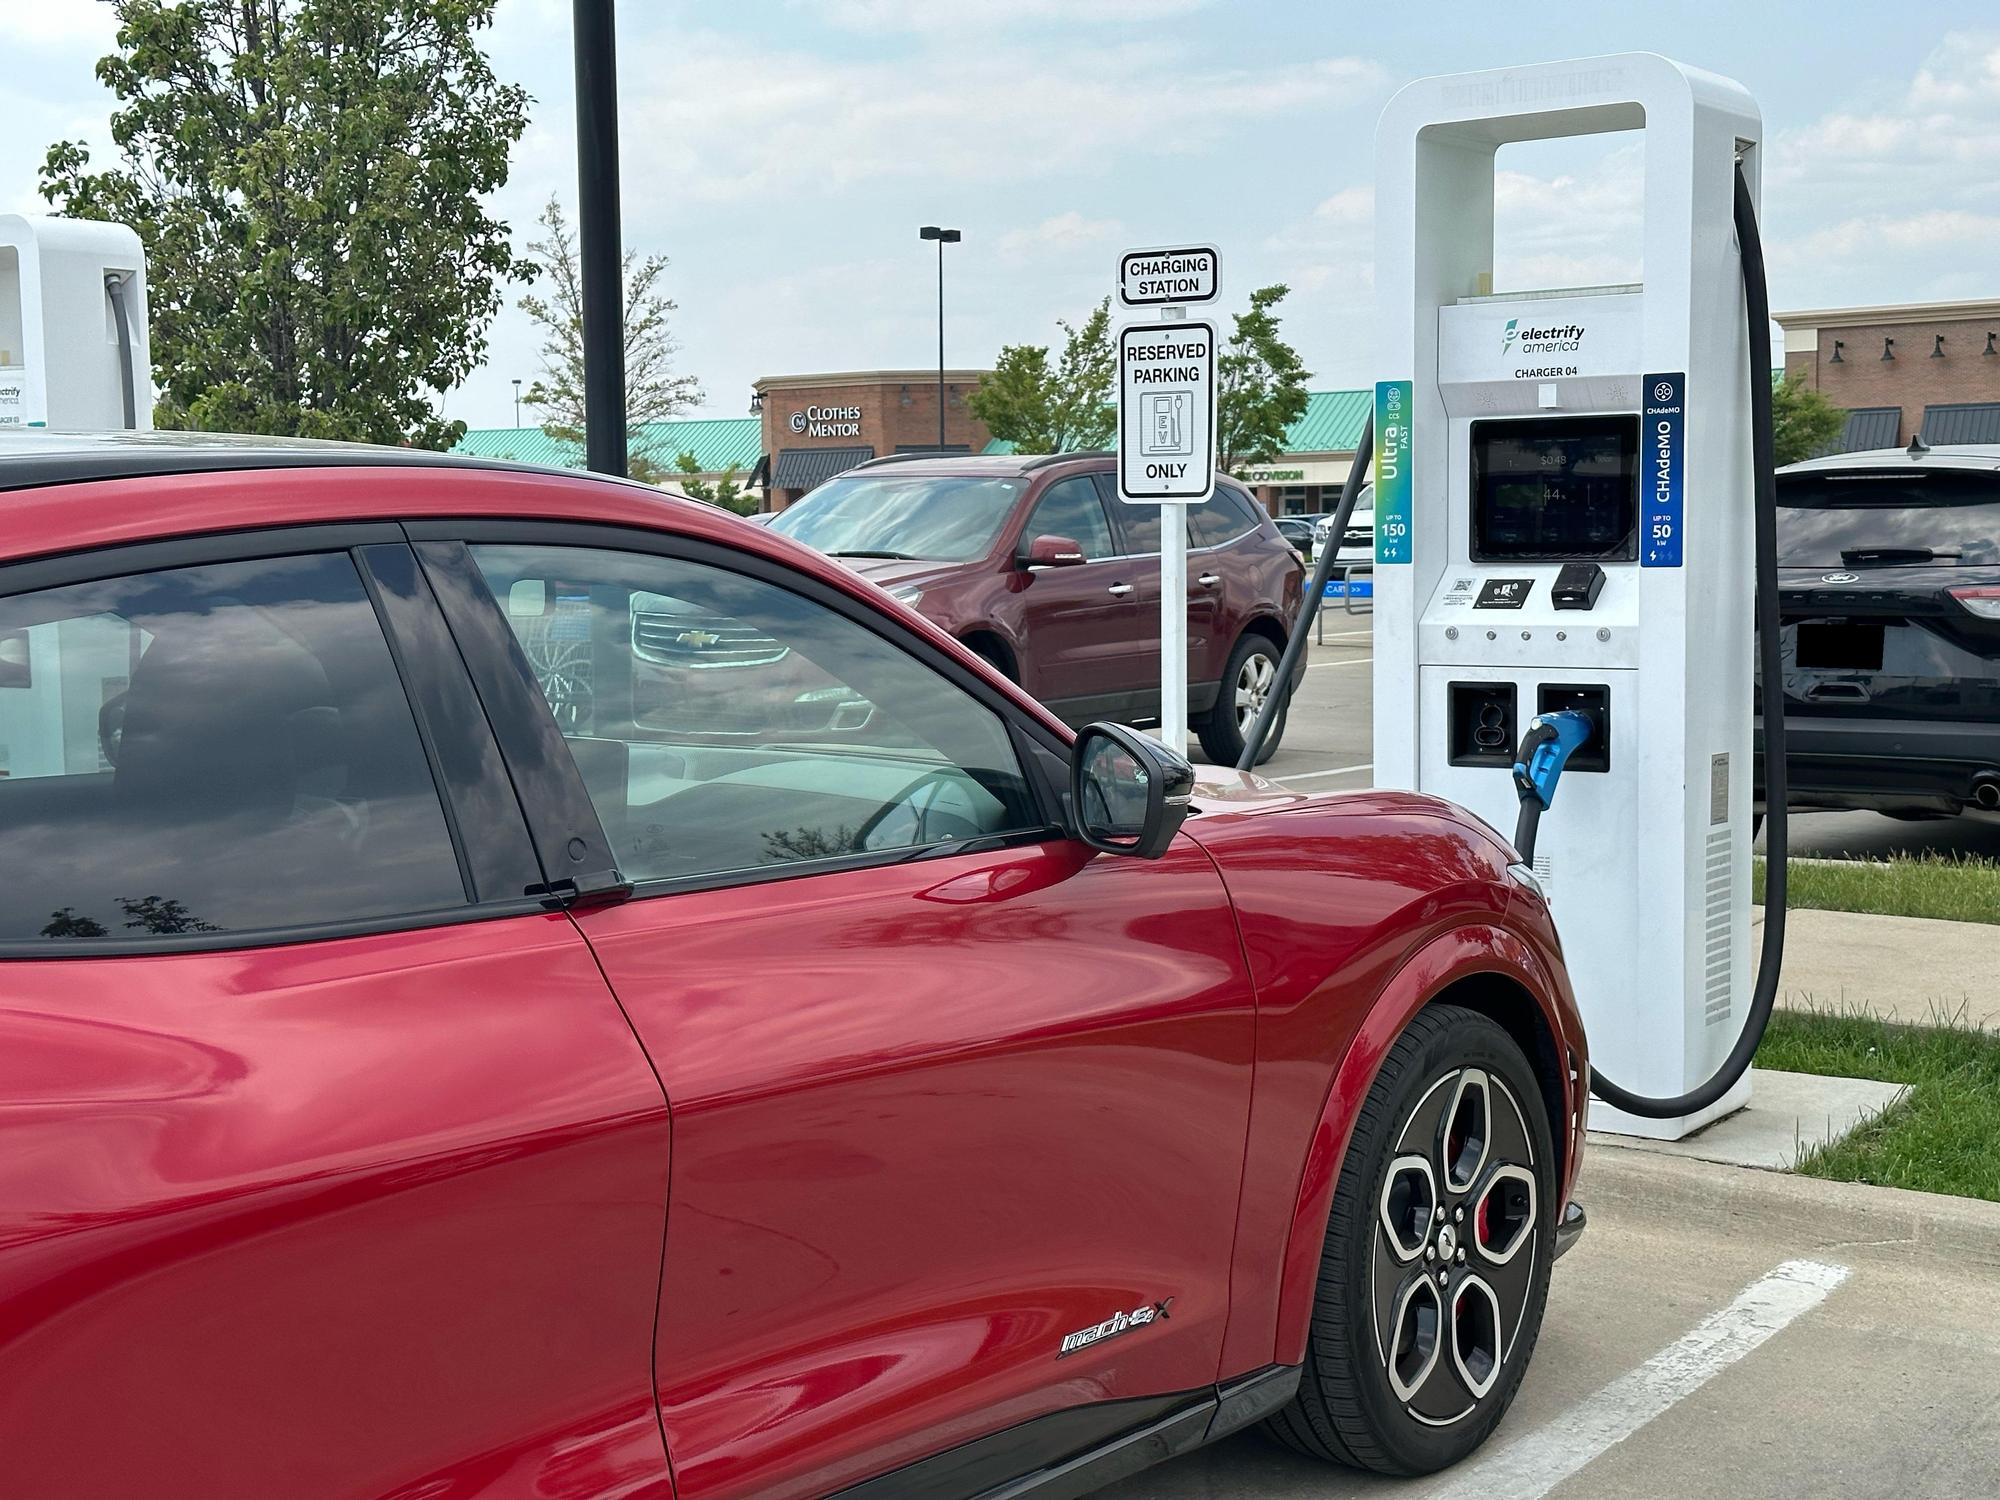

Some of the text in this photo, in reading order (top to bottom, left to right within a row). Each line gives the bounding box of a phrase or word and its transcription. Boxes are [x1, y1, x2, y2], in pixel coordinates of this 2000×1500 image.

[1129, 258, 1209, 277] CHARGING
[1138, 278, 1200, 295] STATION
[1521, 325, 1585, 341] electrify
[1126, 343, 1206, 362] RESERVED
[1522, 340, 1580, 353] america
[1134, 366, 1200, 384] PARKING
[1514, 366, 1578, 379] CHARGER 04
[807, 405, 861, 421] CLOTHES
[1646, 407, 1680, 415] CHAdeMO
[808, 422, 860, 437] MENTOR
[1400, 425, 1408, 449] FAST
[1381, 426, 1398, 479] Ultra
[1656, 421, 1671, 503] CHAdeMO
[1145, 463, 1187, 479] ONLY
[1381, 523, 1406, 537] 150
[1652, 524, 1672, 539] 50
